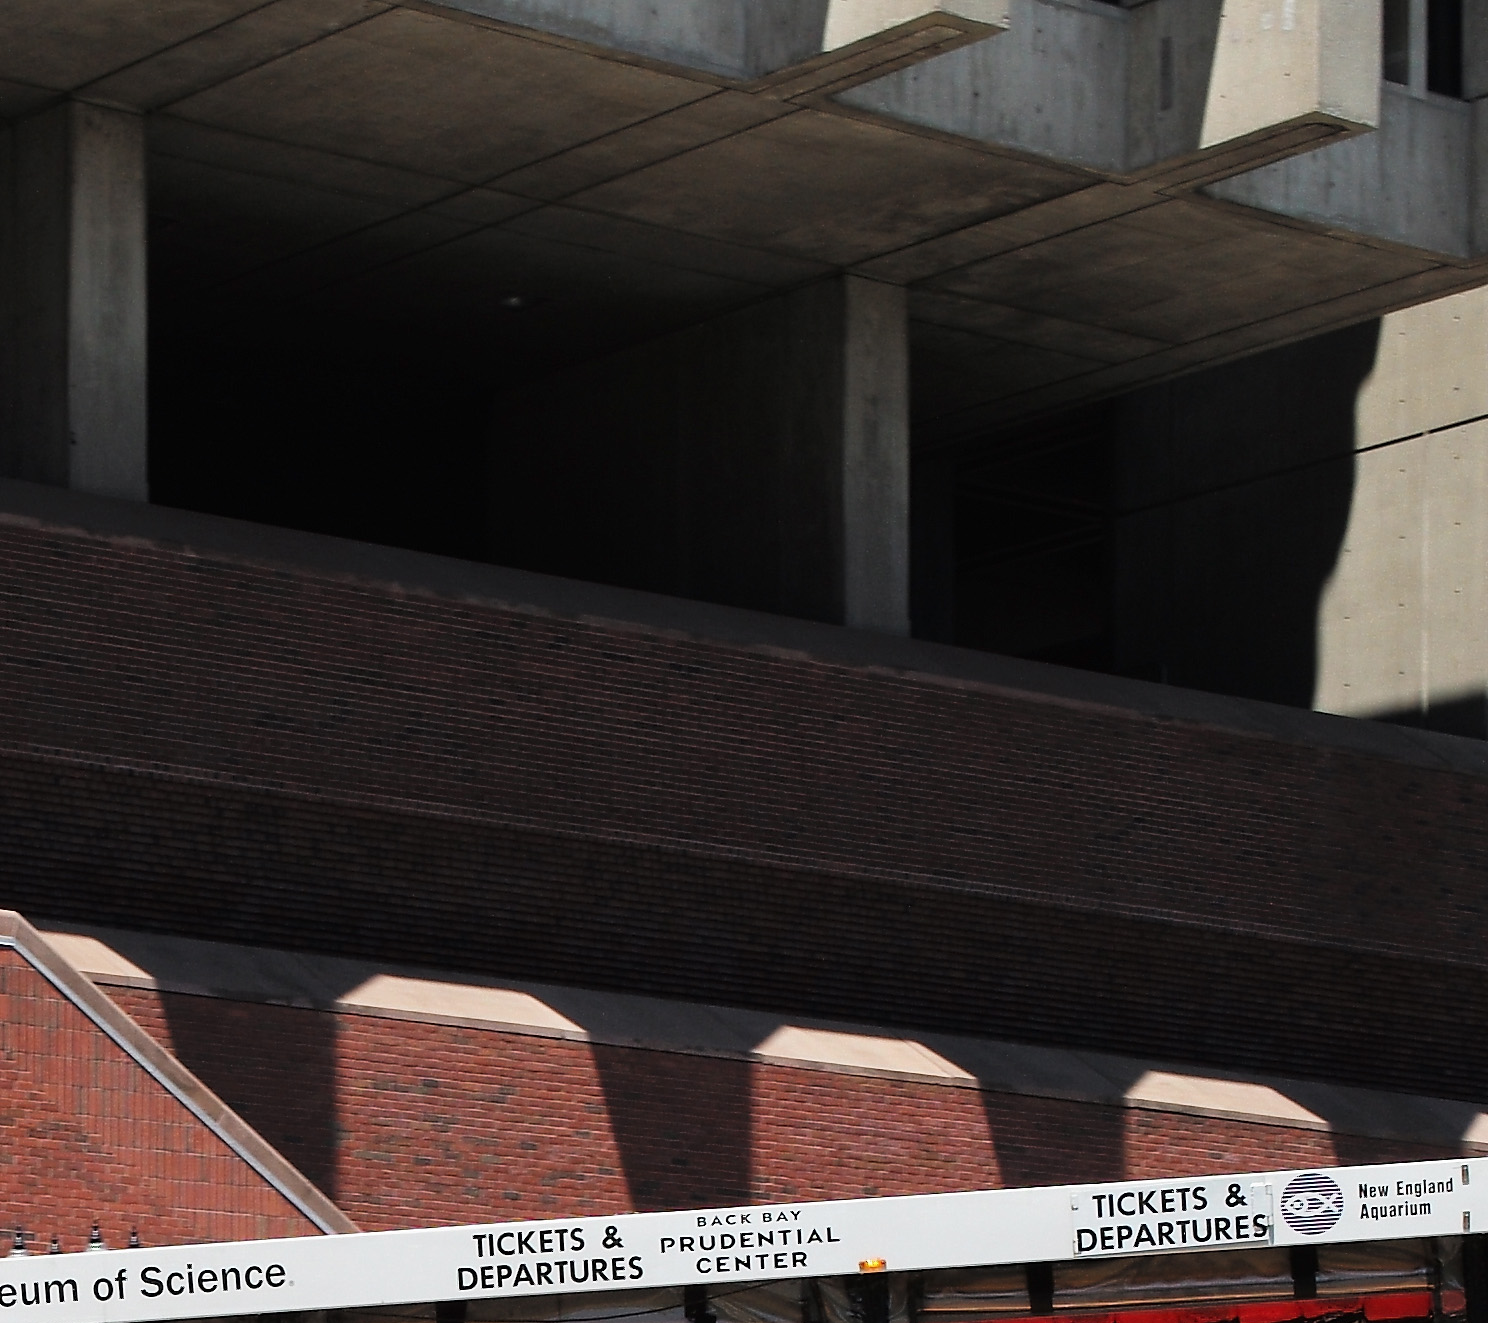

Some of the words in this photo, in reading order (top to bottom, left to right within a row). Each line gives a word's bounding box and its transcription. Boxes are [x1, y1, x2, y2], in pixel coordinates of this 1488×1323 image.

[1092, 1187, 1208, 1219] TICKETS
[1224, 1183, 1248, 1208] &
[1358, 1182, 1389, 1200] New
[1396, 1177, 1454, 1199] England
[696, 1213, 751, 1228] BACK
[762, 1210, 802, 1224] BAY
[1359, 1200, 1432, 1221] Aquarium
[472, 1228, 585, 1258] TICKETS
[602, 1225, 624, 1249] &
[660, 1226, 841, 1254] PRUDENTIAL
[1076, 1213, 1269, 1253] DEPARTURES
[457, 1256, 644, 1291] DEPARTURES
[696, 1251, 808, 1275] CENTER
[92, 1267, 129, 1301] of
[131, 1260, 288, 1297] Science
